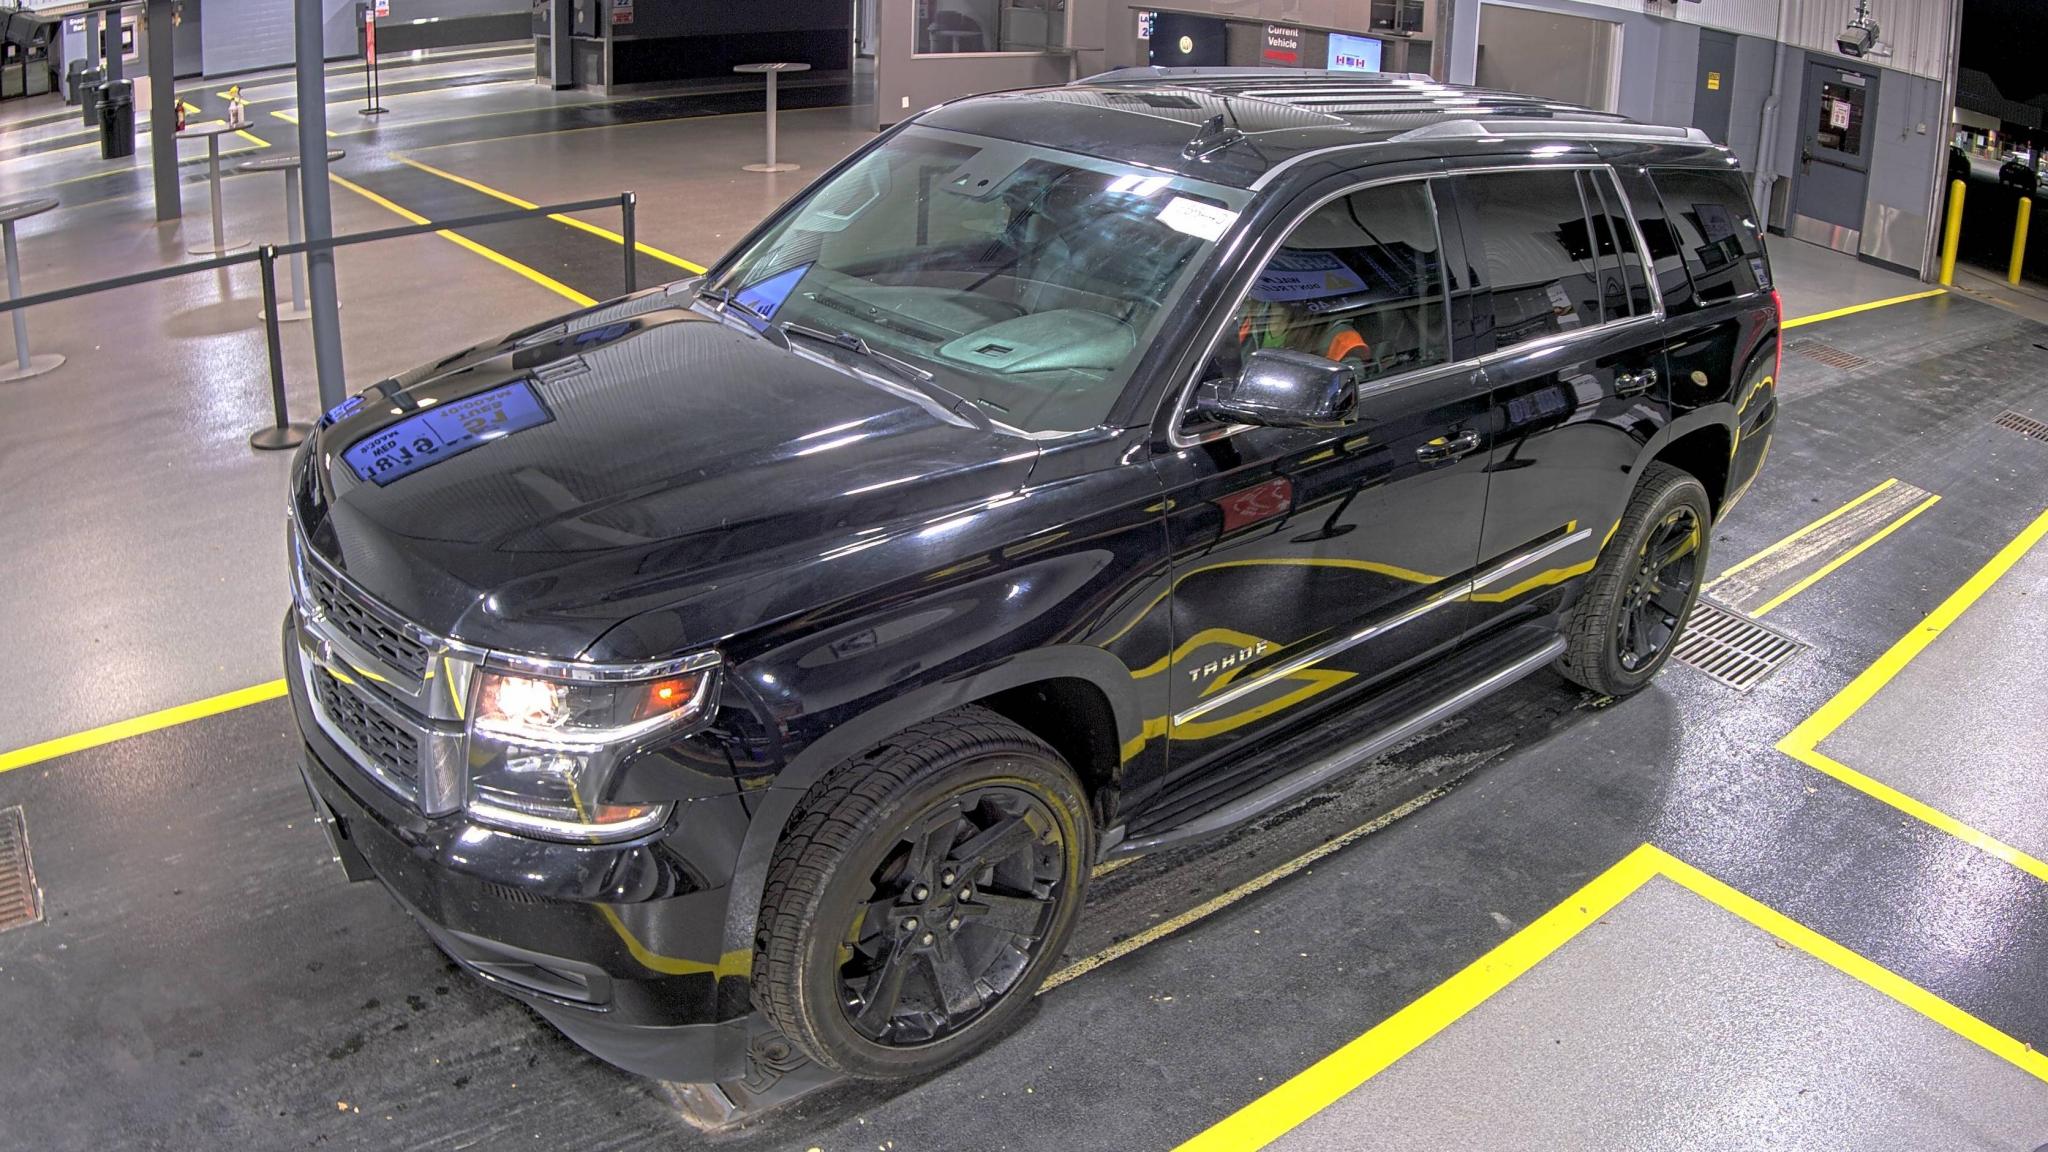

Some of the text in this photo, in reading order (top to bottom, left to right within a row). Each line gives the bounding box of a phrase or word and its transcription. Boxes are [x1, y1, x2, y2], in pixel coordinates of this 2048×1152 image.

[1142, 28, 1149, 36] 2
[1268, 25, 1299, 37] Current
[1268, 36, 1298, 48] Vehicle
[1188, 640, 1268, 682] TAHOE
